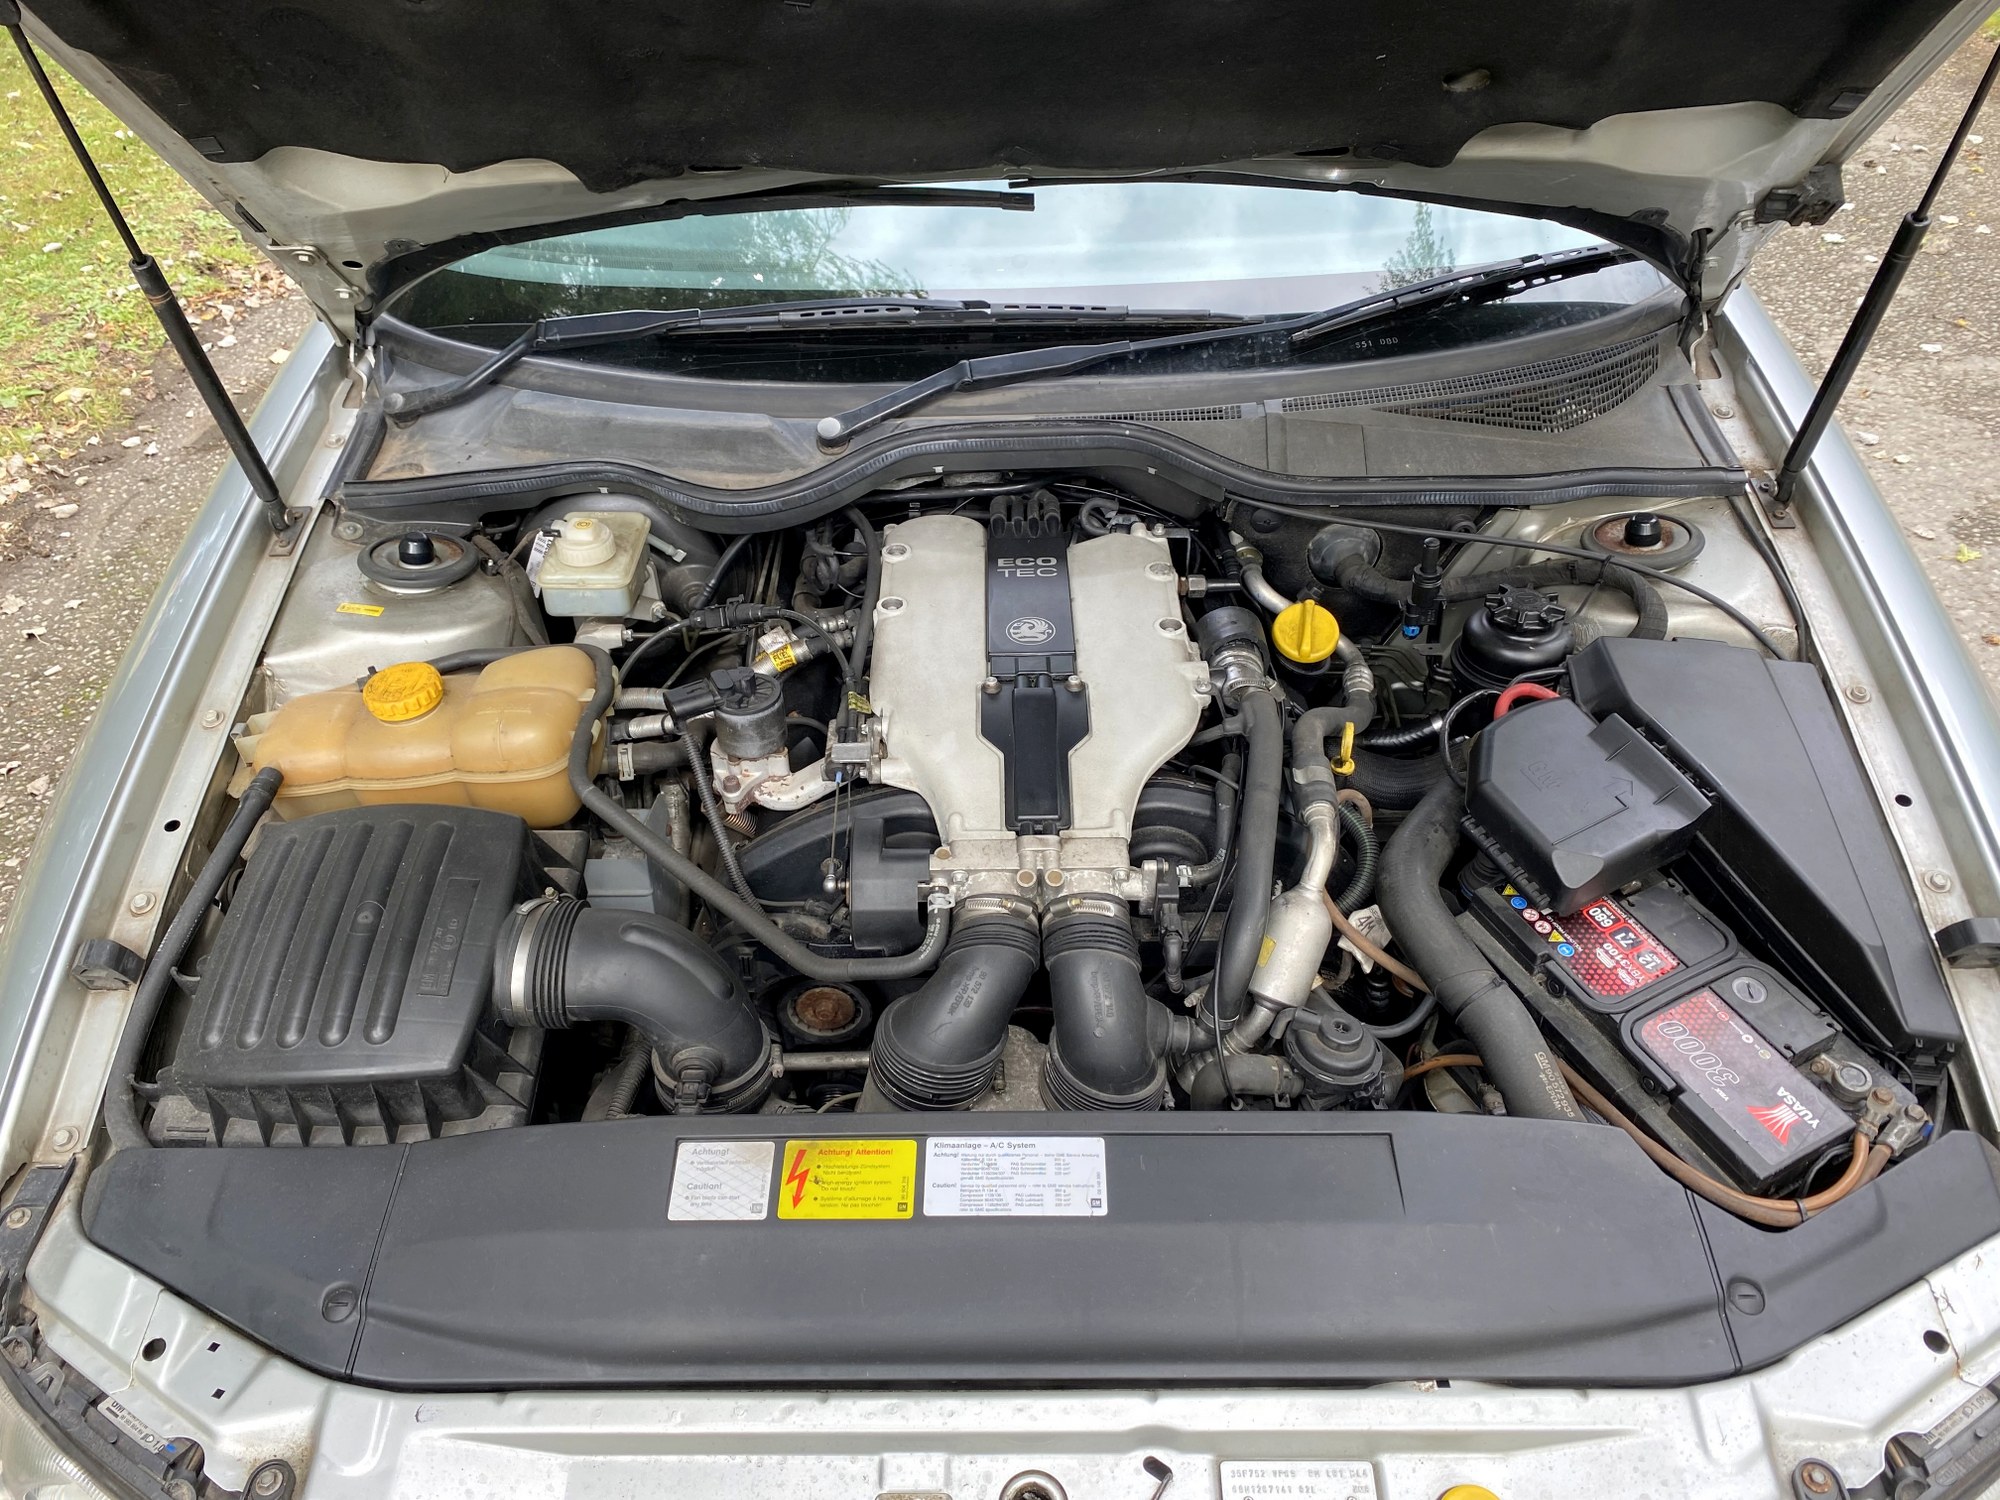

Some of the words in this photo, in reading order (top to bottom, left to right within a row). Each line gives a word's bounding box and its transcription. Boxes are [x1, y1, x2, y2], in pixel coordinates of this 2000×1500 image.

[998, 557, 1057, 567] ECO
[997, 568, 1057, 578] TEC
[1589, 907, 1613, 927] 680
[1614, 932, 1633, 948] 71
[1603, 942, 1645, 982] YBX3100
[1638, 955, 1657, 970] 12
[1657, 1020, 1740, 1088] 3000
[1552, 1082, 1565, 1100] 572
[1561, 1100, 1576, 1117] 935
[1777, 1086, 1820, 1129] YUASA
[692, 1148, 729, 1156] Achtung!
[818, 1148, 853, 1156] Achtung!
[934, 1142, 982, 1150] Klimaanlage
[1007, 1142, 1036, 1150] System
